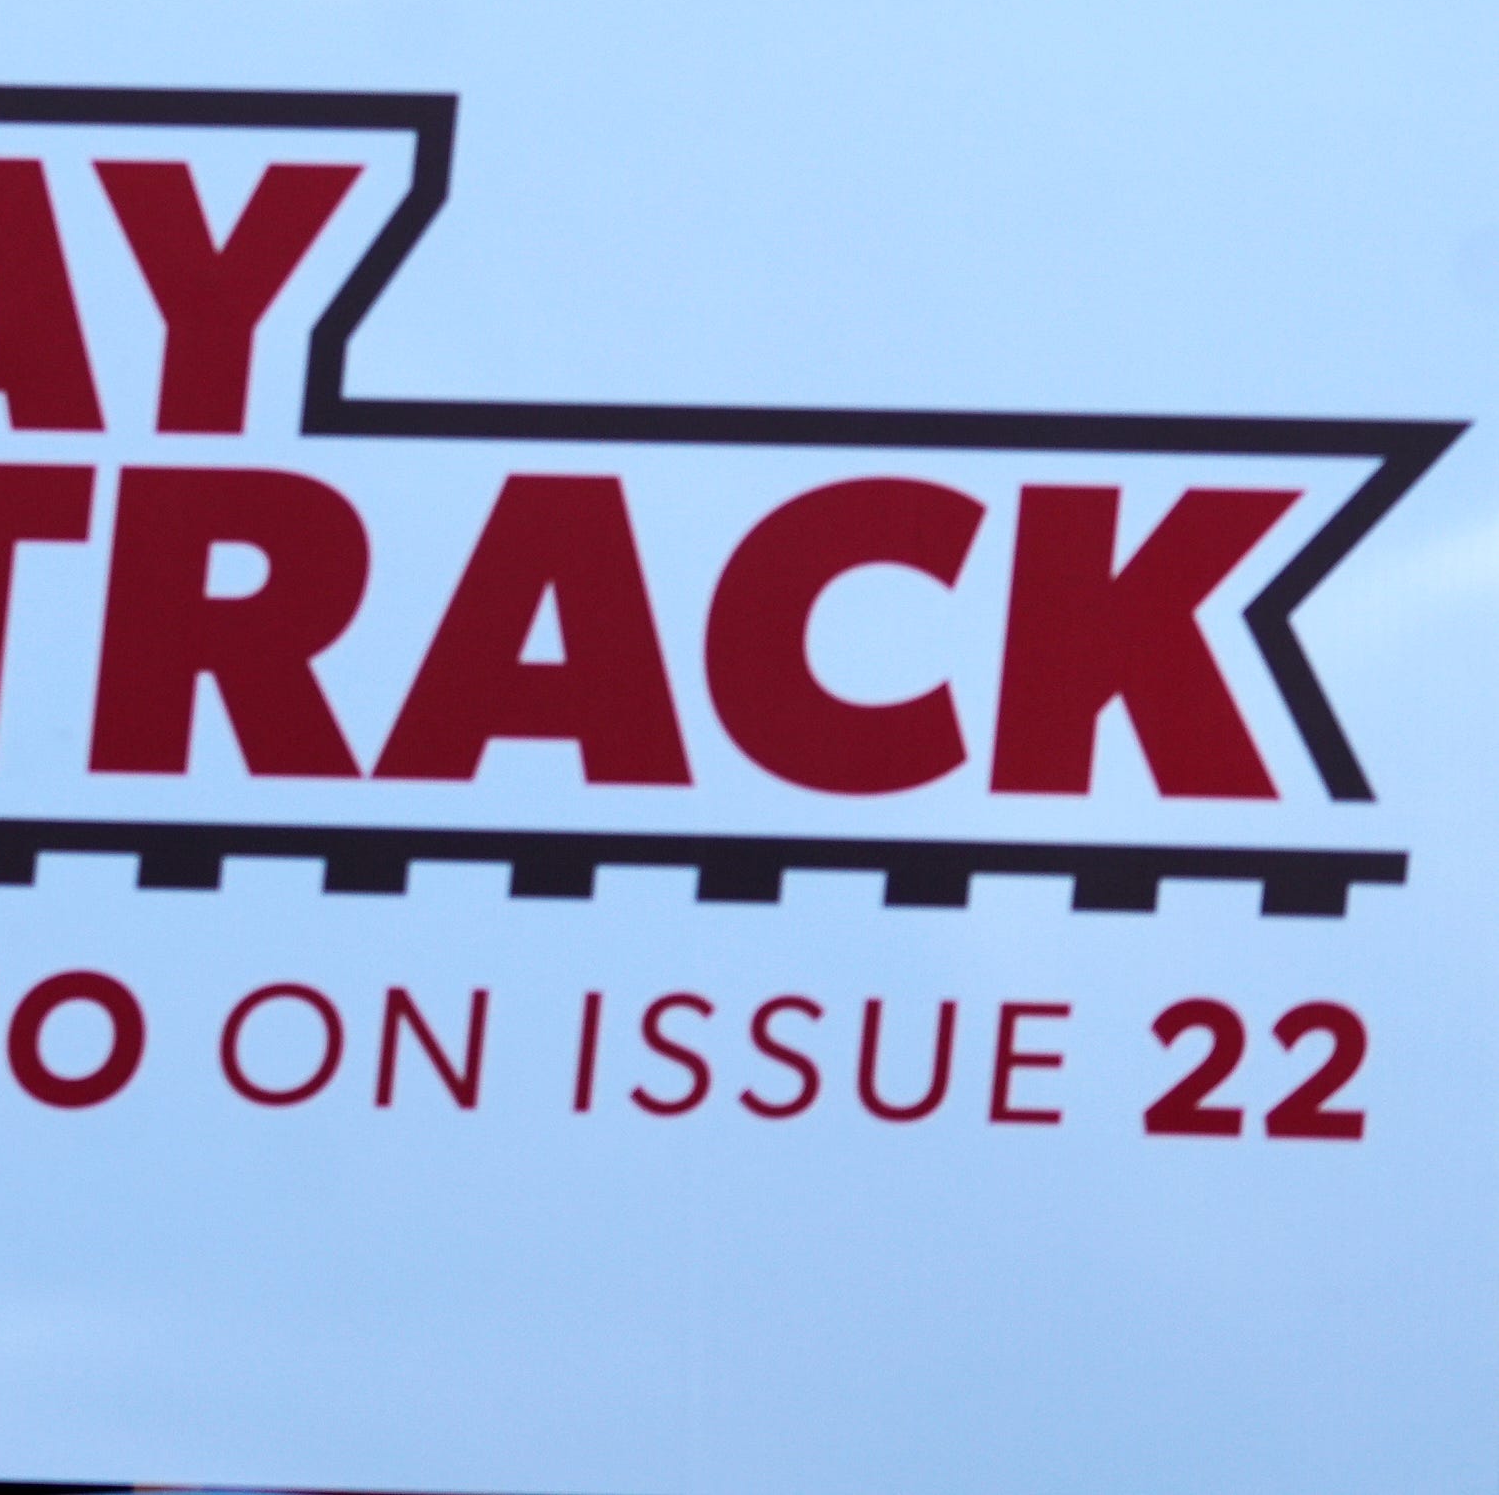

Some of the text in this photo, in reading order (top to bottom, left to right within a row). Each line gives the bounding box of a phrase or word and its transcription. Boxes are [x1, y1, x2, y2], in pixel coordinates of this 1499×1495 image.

[219, 982, 489, 1110] ON
[573, 991, 1072, 1125] ISSUE
[1143, 997, 1369, 1141] 22
